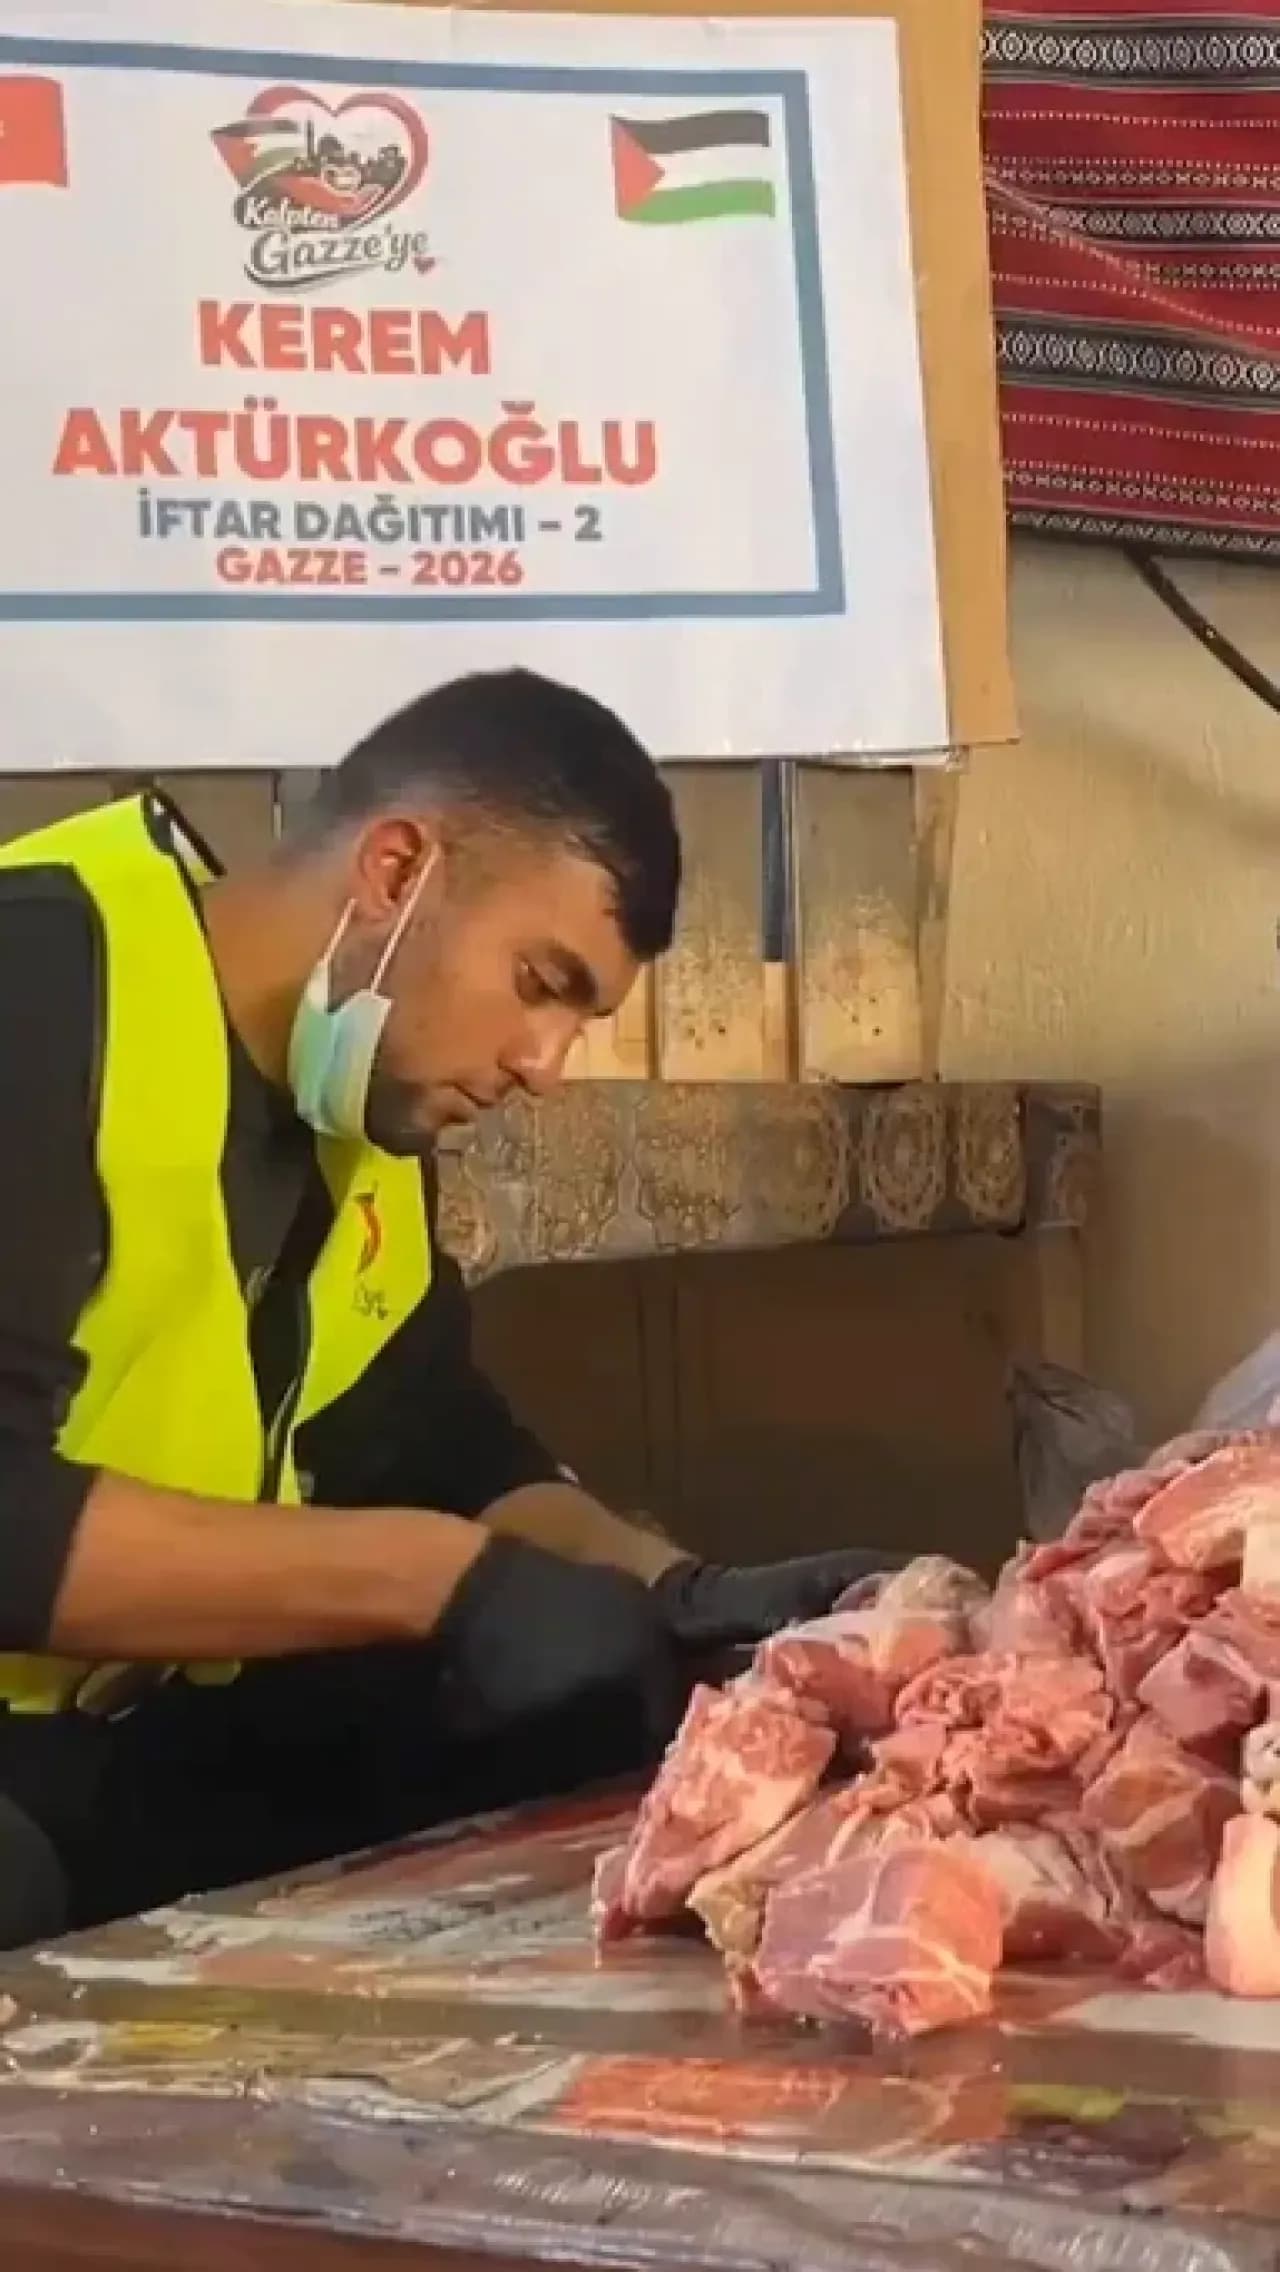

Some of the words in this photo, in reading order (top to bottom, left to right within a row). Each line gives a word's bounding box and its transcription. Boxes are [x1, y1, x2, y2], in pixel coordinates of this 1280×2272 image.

[250, 222, 428, 274] Gazze'ye
[199, 300, 491, 375] KEREM
[53, 396, 658, 486] AKTÜRKOĞLU
[138, 487, 282, 540] İFTAR
[294, 494, 526, 543] DAĞITIMI
[574, 505, 603, 542] 2
[216, 547, 368, 585] GAZZE
[411, 550, 524, 586] 2026
